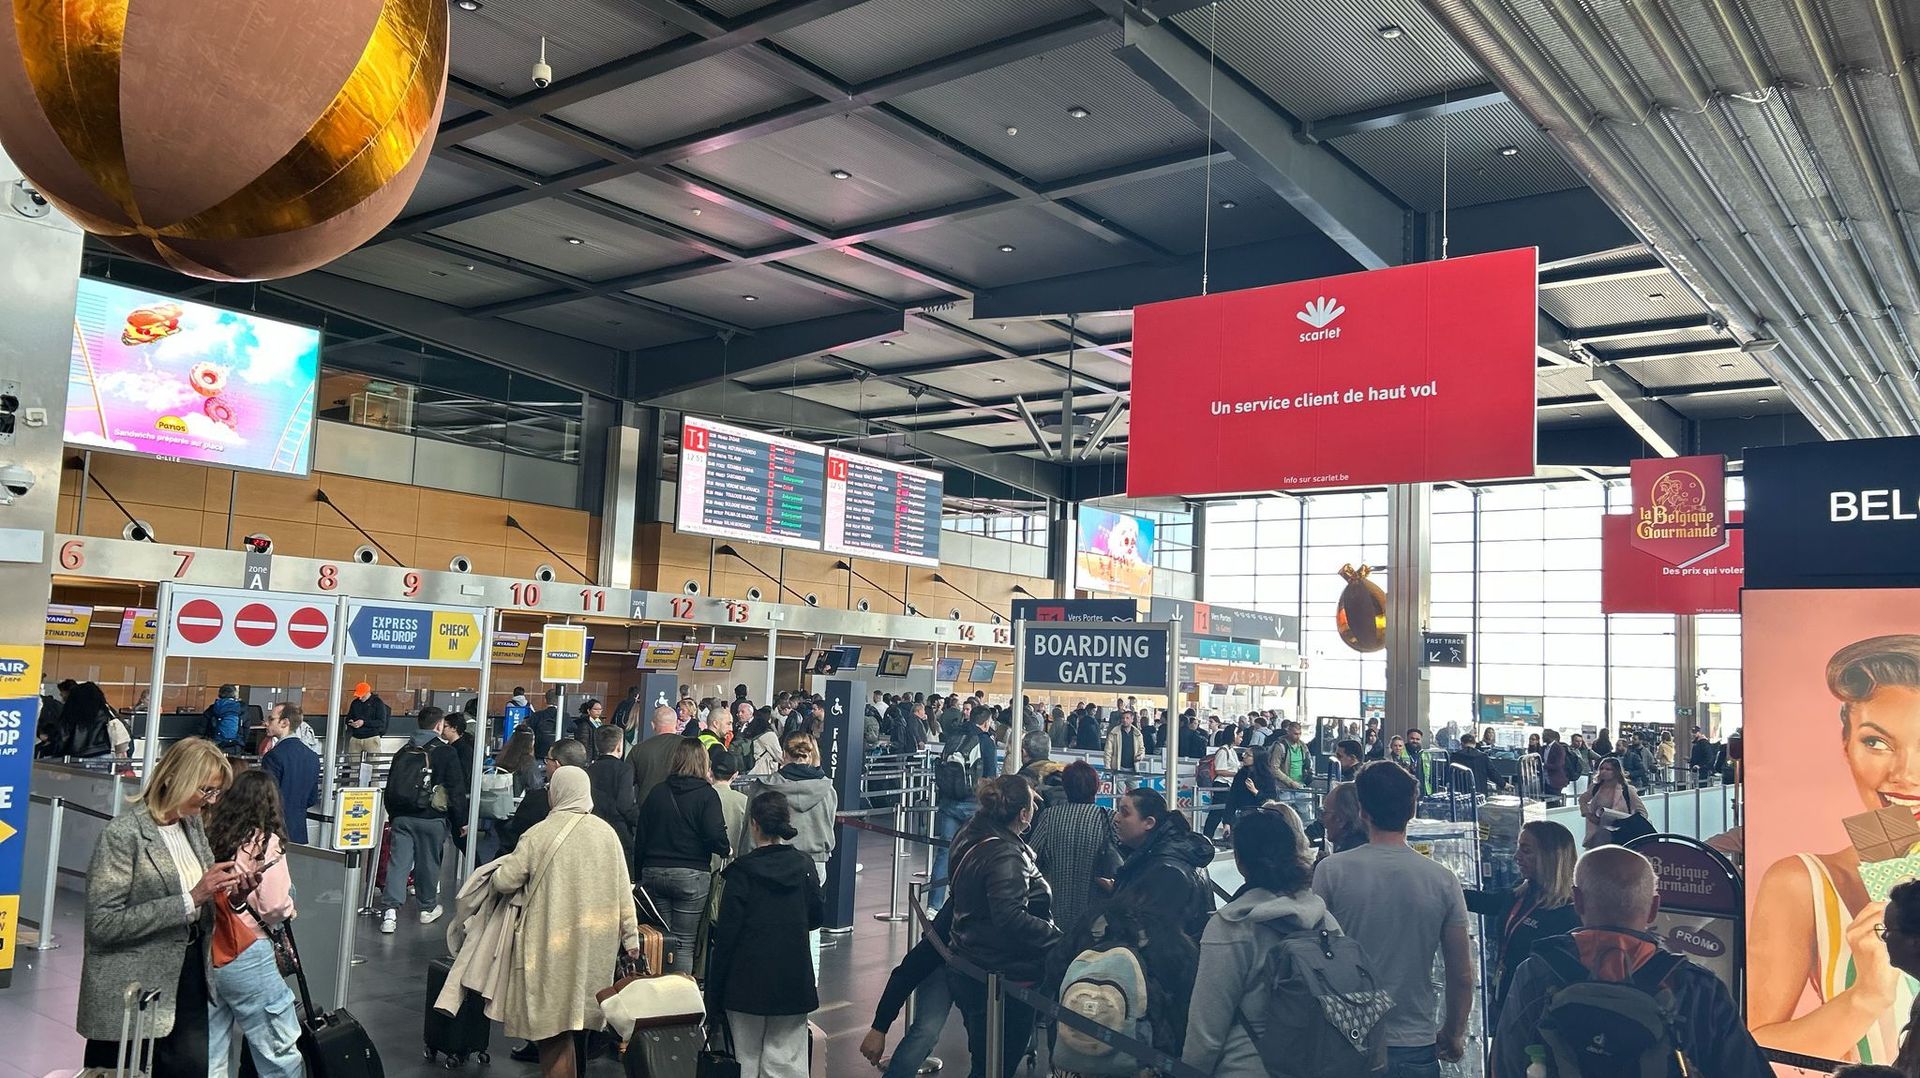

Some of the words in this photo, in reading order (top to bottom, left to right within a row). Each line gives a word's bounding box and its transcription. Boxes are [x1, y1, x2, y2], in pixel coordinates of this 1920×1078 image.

[1299, 326, 1341, 343] scarlet
[1210, 400, 1231, 416] Un
[1234, 396, 1290, 414] service
[1294, 391, 1340, 409] client
[1343, 388, 1364, 404] de
[1368, 384, 1406, 402] haut
[1410, 380, 1437, 397] vol
[158, 421, 186, 432] Panos
[687, 428, 705, 449] T1
[831, 459, 846, 478] T1
[1283, 475, 1297, 484] Info
[1312, 473, 1349, 482] scarlet.be
[1830, 489, 1920, 522] BEL
[1640, 507, 1652, 520] la
[1651, 505, 1714, 527] Belgique
[1636, 520, 1718, 540] Gourmande
[60, 540, 84, 570] 6
[173, 550, 195, 578] 7
[249, 565, 268, 574] zone
[318, 564, 338, 590] 8
[1662, 567, 1680, 575] Des
[1682, 566, 1701, 577] prix
[1703, 566, 1717, 576] qui
[249, 573, 263, 590] A
[403, 572, 422, 597] 9
[510, 582, 541, 607] 10
[580, 589, 605, 612] 11
[633, 606, 642, 619] A
[670, 597, 695, 619] 12
[726, 602, 749, 623] 13
[1068, 613, 1082, 622] Vers
[1082, 613, 1104, 622] Portes
[372, 616, 418, 630] EXPRESS
[439, 623, 470, 637] CHECK
[958, 624, 976, 641] 14
[371, 629, 391, 641] BAG
[392, 630, 418, 642] DROP
[448, 638, 458, 650] IN
[993, 628, 1009, 644] 15
[1034, 634, 1150, 659] BOARDING
[1058, 661, 1127, 687] GATES
[2, 748, 18, 756] APP
[831, 727, 839, 779] FAST
[1649, 856, 1709, 882] Belgique
[1676, 930, 1719, 952] PROMO
